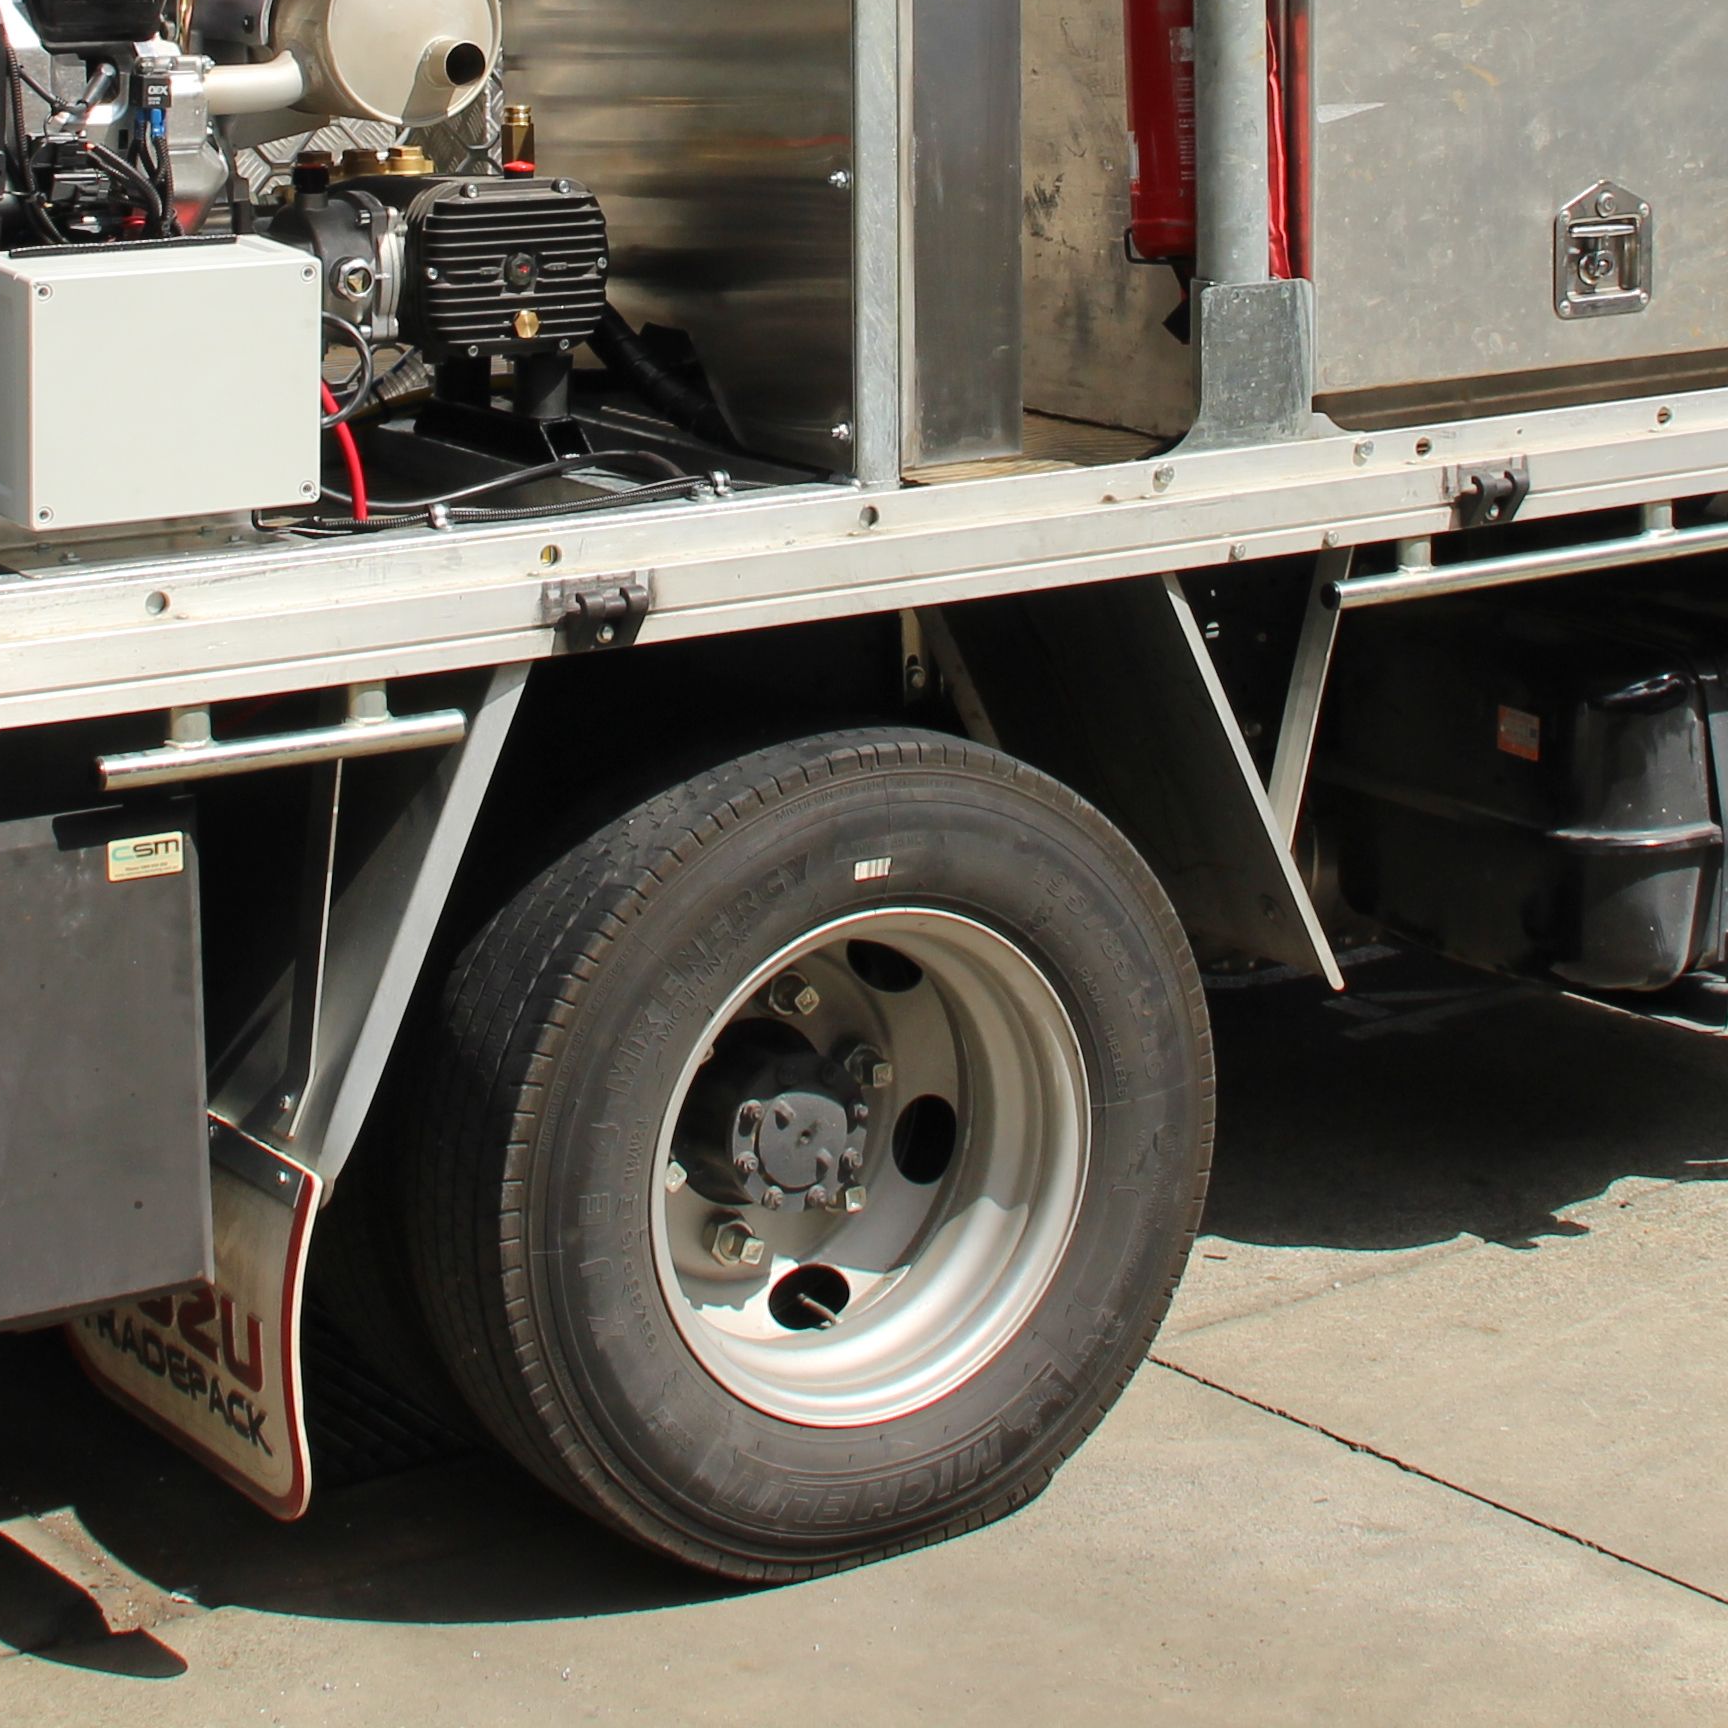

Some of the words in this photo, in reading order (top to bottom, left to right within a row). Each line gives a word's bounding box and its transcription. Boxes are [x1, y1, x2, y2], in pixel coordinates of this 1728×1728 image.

[646, 847, 813, 1010] ENERGY
[84, 1309, 273, 1457] RADEPACK
[709, 1427, 1003, 1524] MICHELIN
